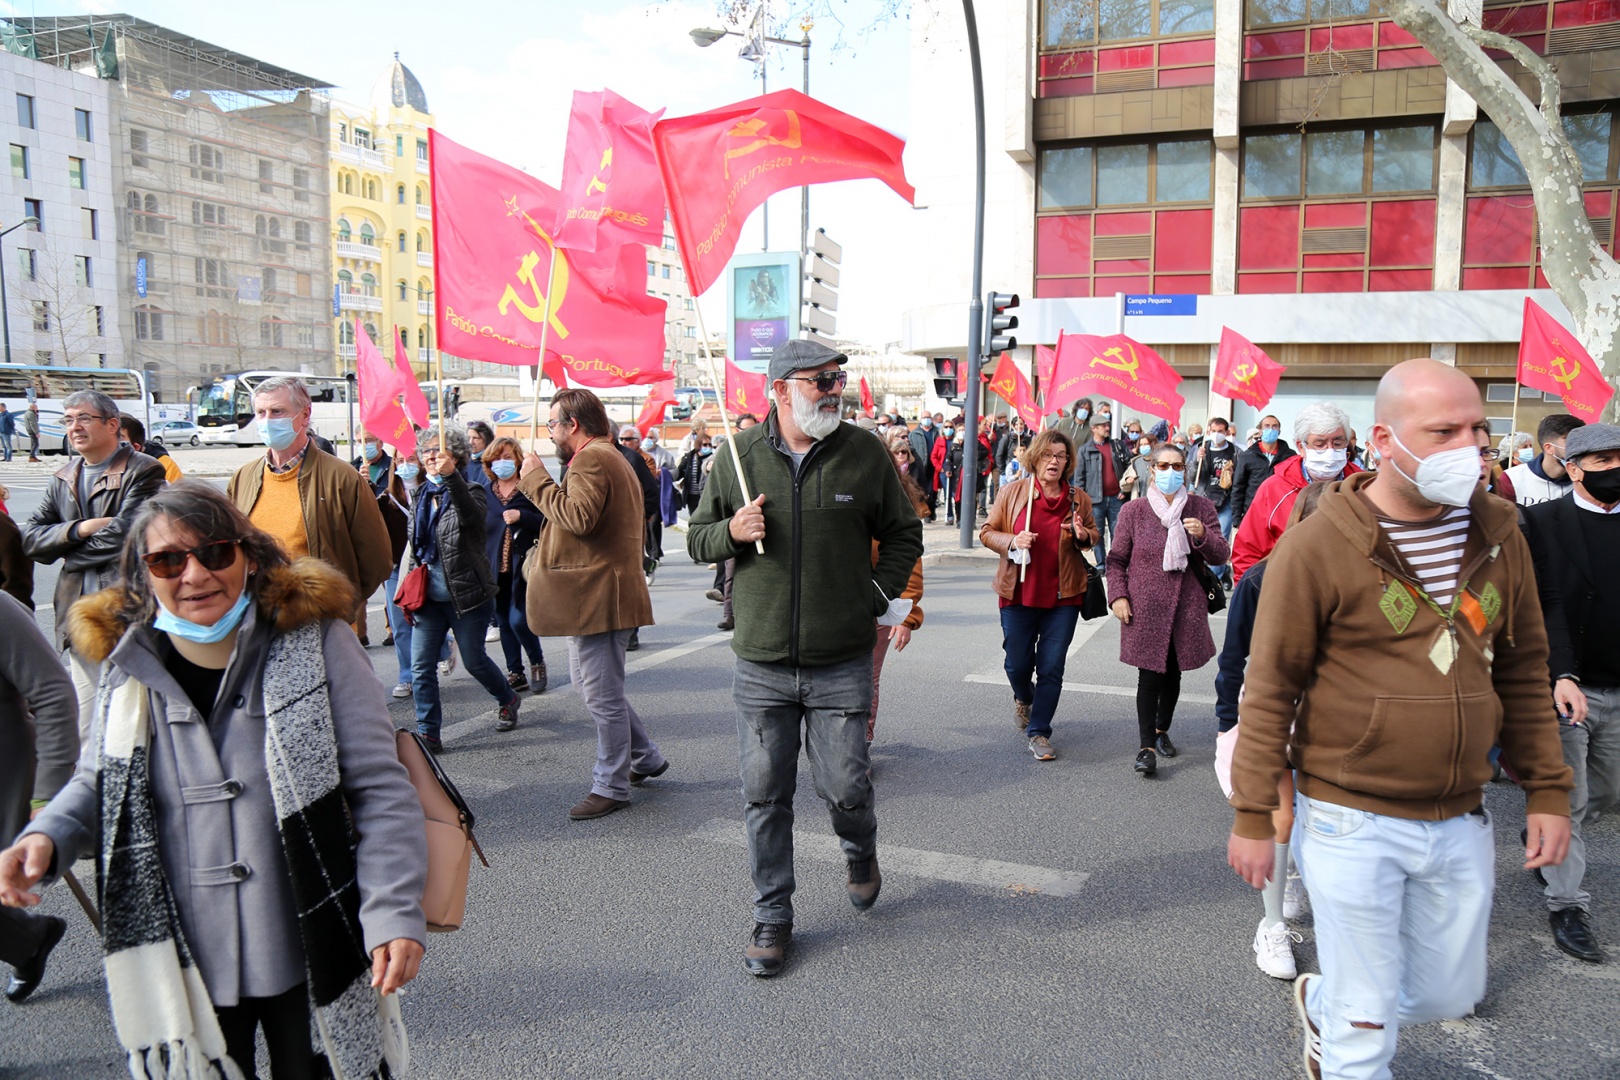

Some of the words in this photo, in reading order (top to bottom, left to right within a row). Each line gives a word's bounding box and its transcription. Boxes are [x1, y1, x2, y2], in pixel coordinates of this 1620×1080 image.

[696, 213, 728, 262] Partido
[561, 354, 641, 379] Portugu
[1523, 361, 1547, 374] Partido
[1081, 372, 1128, 390] Comunista
[1562, 394, 1595, 414] Português
